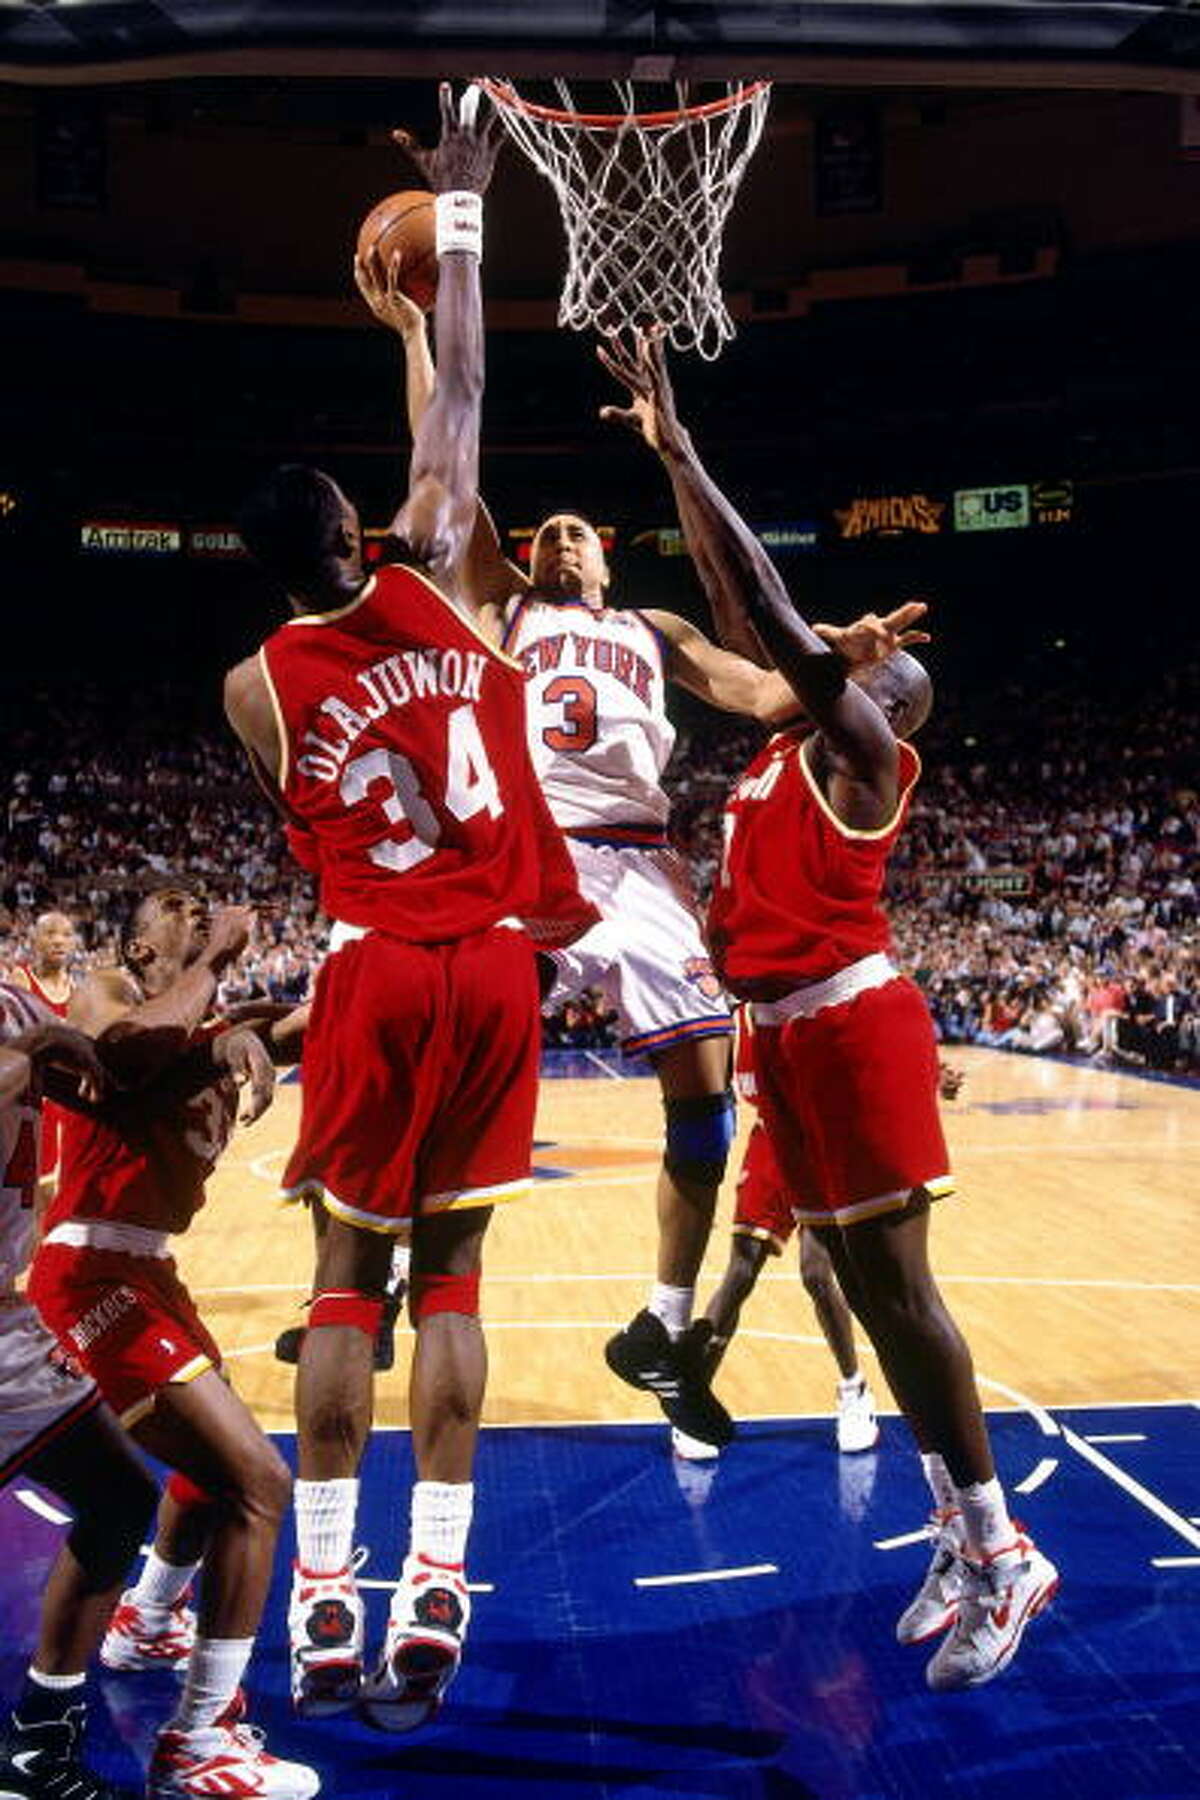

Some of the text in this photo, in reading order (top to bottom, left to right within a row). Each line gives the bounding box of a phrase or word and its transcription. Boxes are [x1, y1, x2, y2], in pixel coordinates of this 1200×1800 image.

[87, 527, 172, 550] Amtrak
[838, 494, 942, 538] KNICKS
[984, 490, 1024, 513] US
[569, 630, 655, 713] YORK
[296, 648, 489, 782] OLAJUWON
[542, 674, 599, 753] 3
[339, 703, 505, 873] 34
